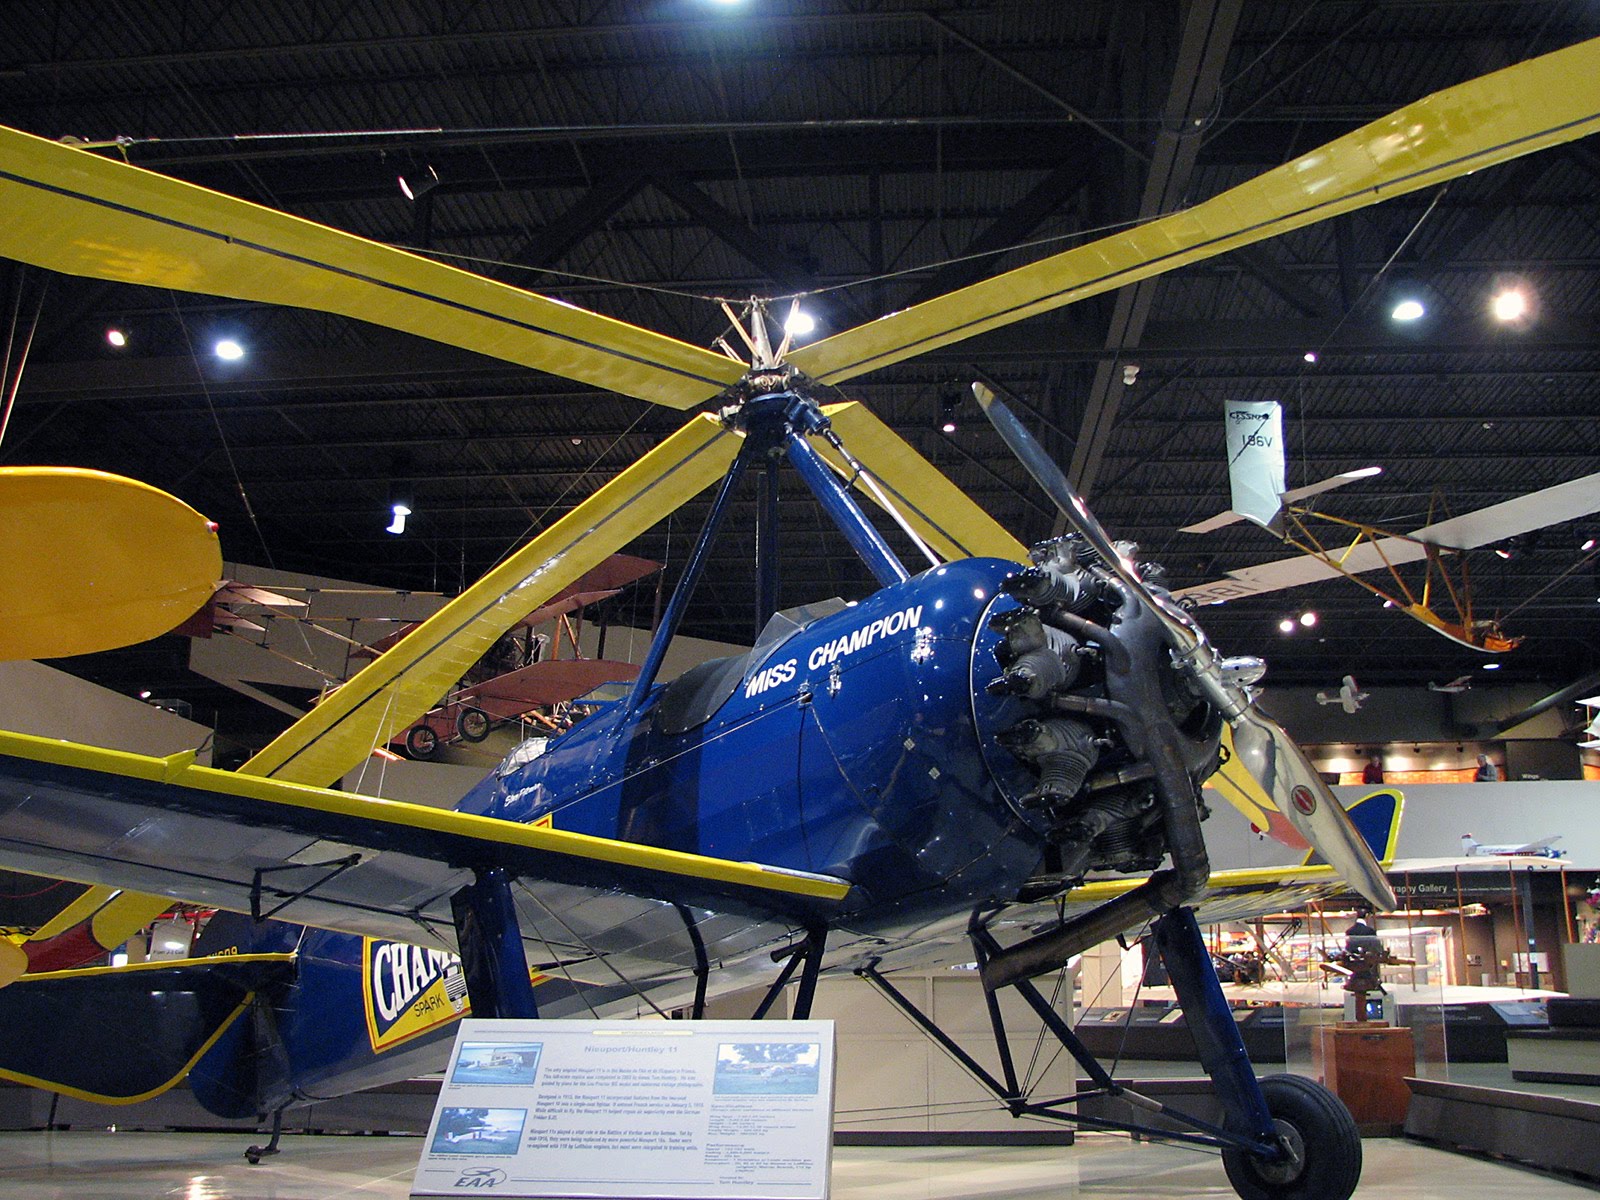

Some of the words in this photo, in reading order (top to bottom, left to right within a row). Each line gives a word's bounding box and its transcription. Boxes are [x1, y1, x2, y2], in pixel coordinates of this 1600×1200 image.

[745, 659, 797, 698] MISS
[808, 605, 923, 671] CHAMPION
[1418, 883, 1448, 893] Gallery
[374, 943, 461, 1021] CHAM
[413, 993, 445, 1017] SPARK
